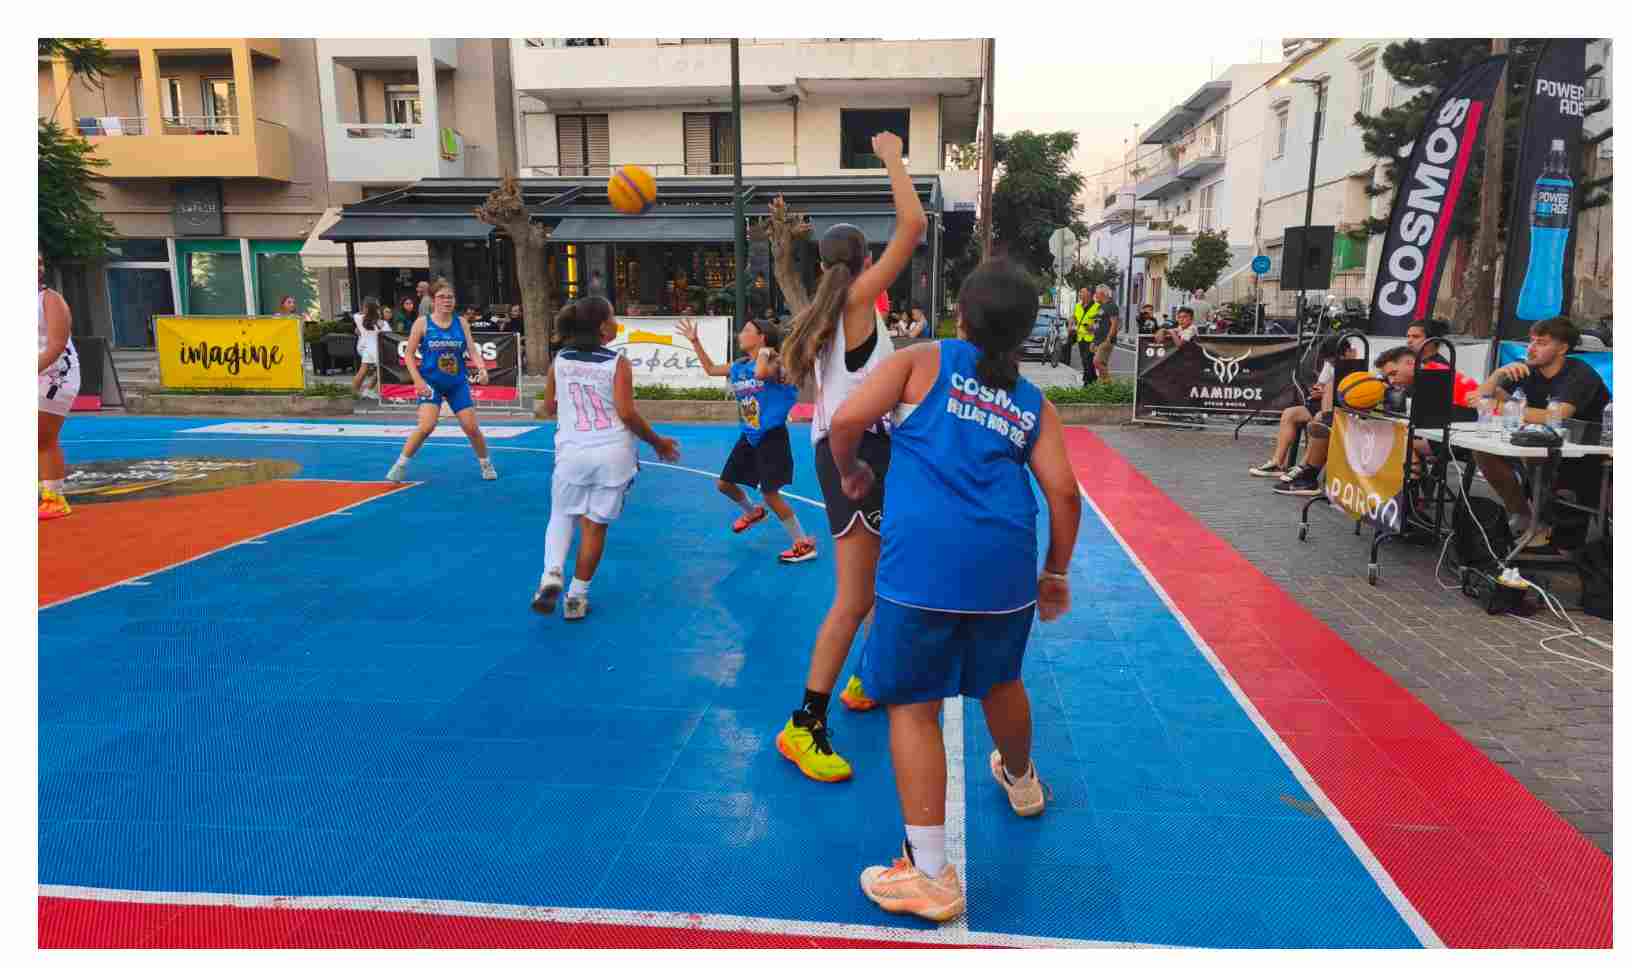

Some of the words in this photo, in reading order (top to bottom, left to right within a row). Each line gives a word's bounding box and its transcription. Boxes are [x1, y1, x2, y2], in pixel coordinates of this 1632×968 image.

[1536, 79, 1584, 100] POWER
[1560, 99, 1584, 117] ADE
[1378, 97, 1471, 317] COSMOS
[179, 340, 285, 375] imagine
[568, 381, 613, 432] 11
[1189, 385, 1264, 401] ΛΑΜΠΡΟΣ
